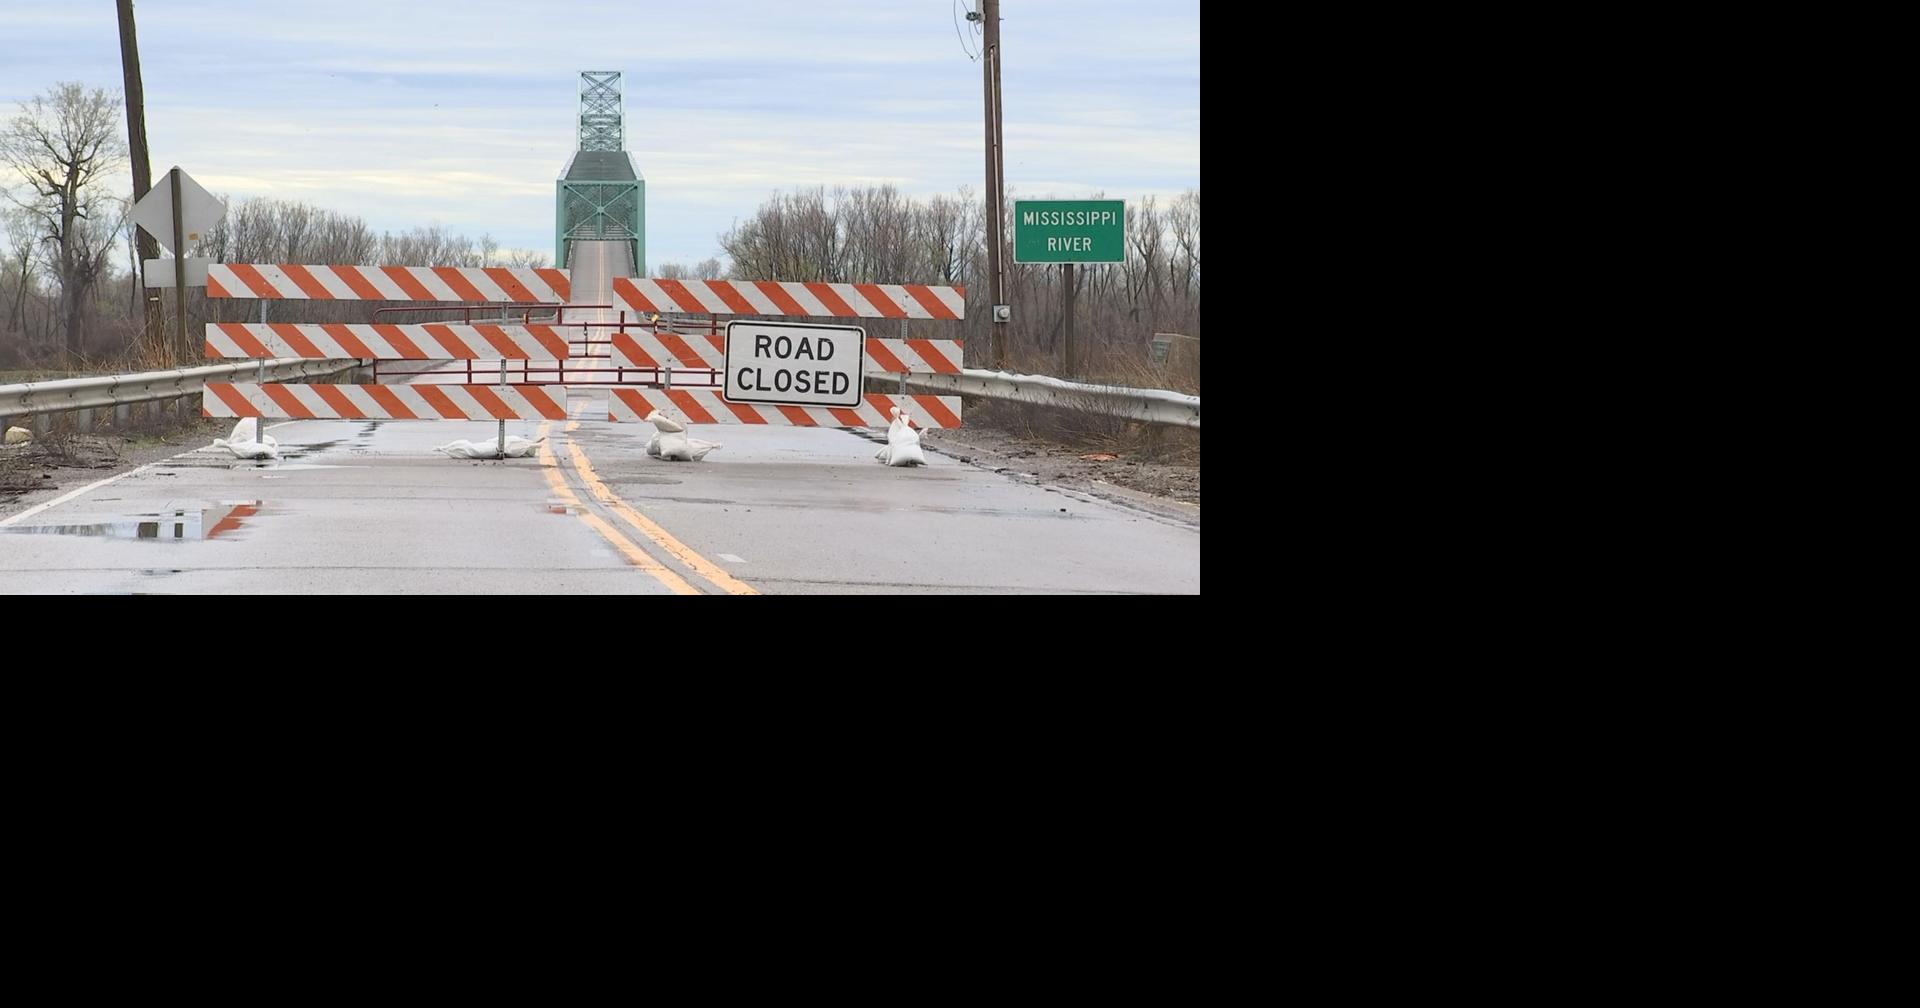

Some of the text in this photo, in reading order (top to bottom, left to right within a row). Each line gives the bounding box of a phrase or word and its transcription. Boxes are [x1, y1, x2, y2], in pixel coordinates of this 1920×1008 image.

[1023, 211, 1116, 226] MISSISSIPPI
[1047, 237, 1092, 252] RIVER
[754, 334, 835, 361] ROAD
[737, 367, 850, 395] CLOSED
